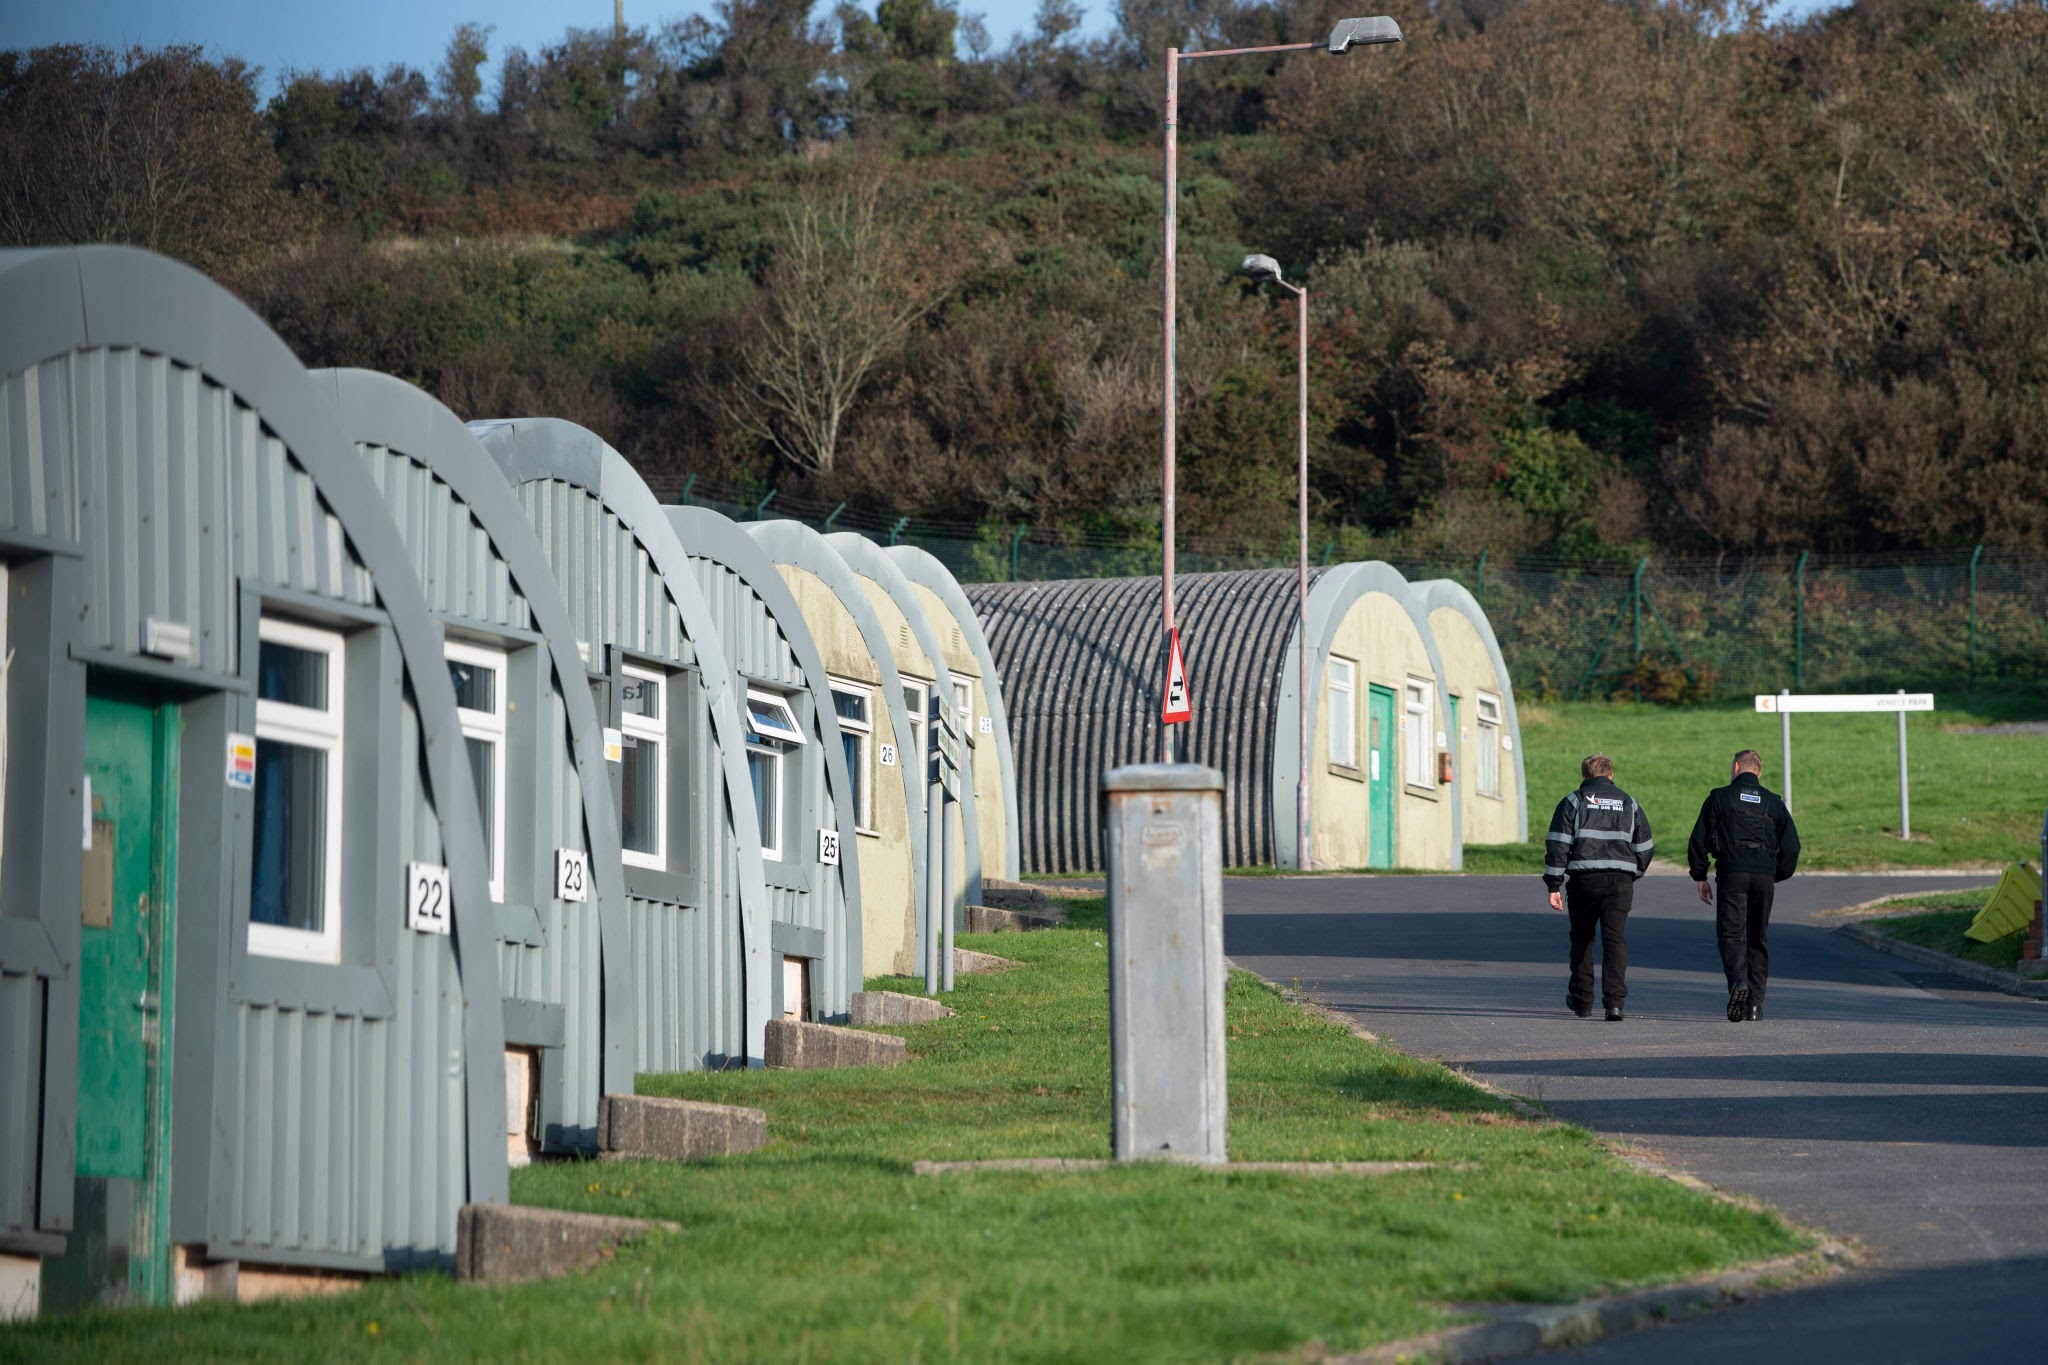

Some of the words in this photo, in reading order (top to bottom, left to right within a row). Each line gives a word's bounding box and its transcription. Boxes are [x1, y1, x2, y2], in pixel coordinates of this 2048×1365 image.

[882, 746, 893, 763] 26
[824, 836, 836, 858] 25
[565, 858, 582, 892] 23
[418, 877, 442, 919] 22
